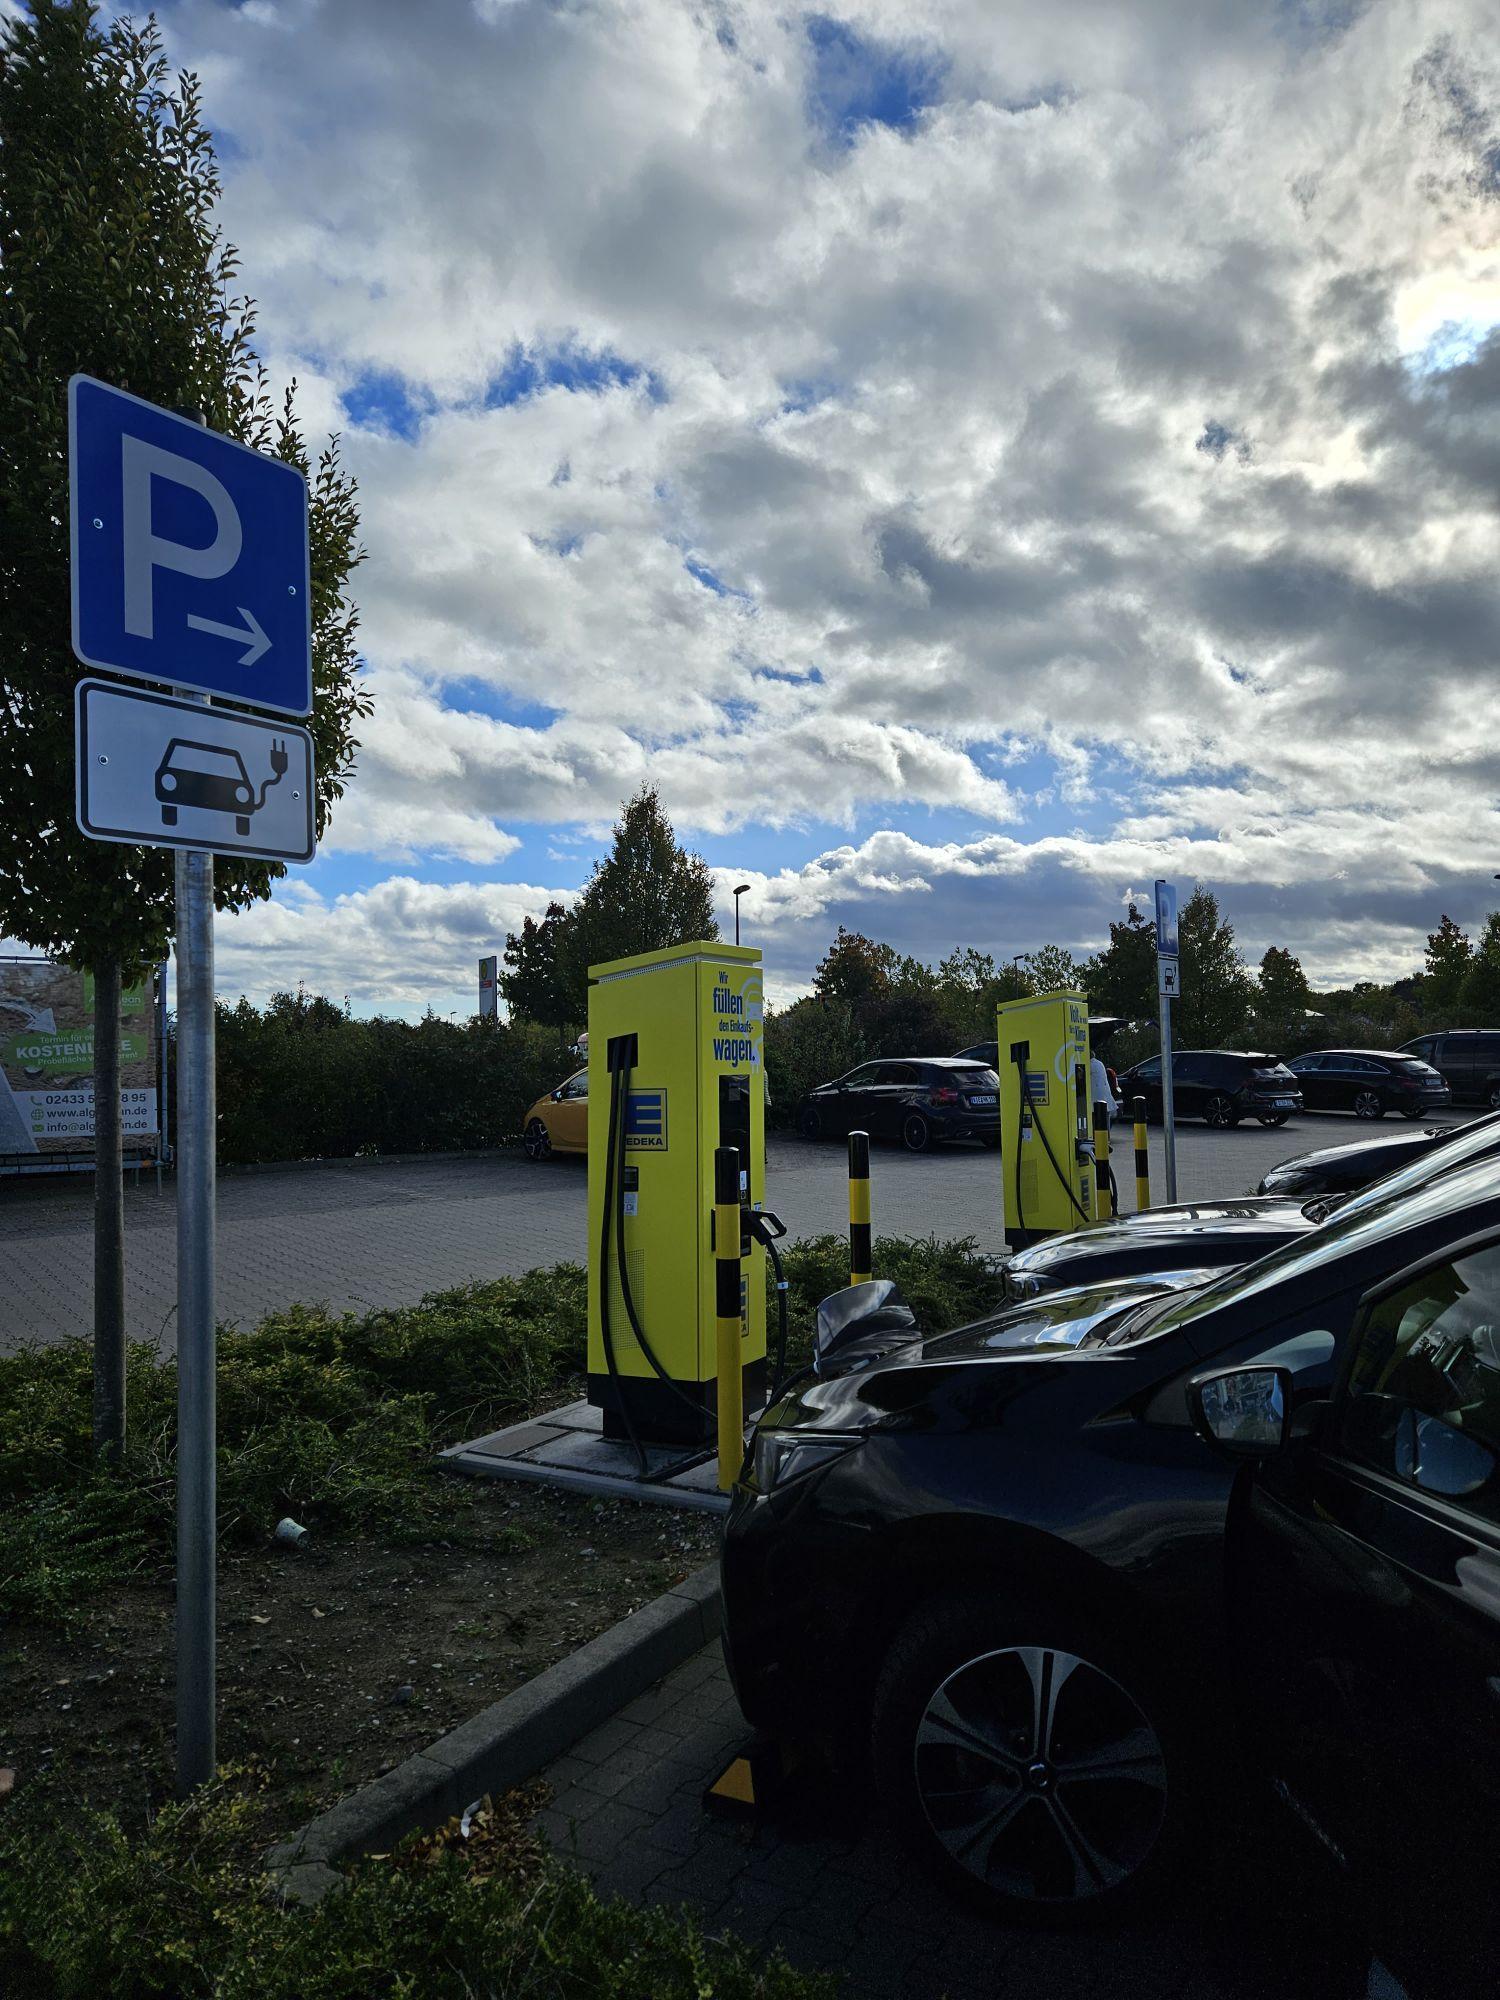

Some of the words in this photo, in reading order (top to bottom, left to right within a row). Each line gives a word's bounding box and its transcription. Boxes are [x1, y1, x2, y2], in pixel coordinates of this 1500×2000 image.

[122, 433, 243, 639] P
[719, 971, 728, 984] Wir
[713, 987, 743, 1015] füllen
[719, 1019, 730, 1032] den
[730, 1019, 754, 1033] Einkaufs-
[16, 1040, 131, 1059] KOSTENLE
[713, 1038, 756, 1068] wagen.
[46, 1094, 85, 1105] 02433
[131, 1093, 146, 1102] 95
[626, 1137, 663, 1146] EDEKA
